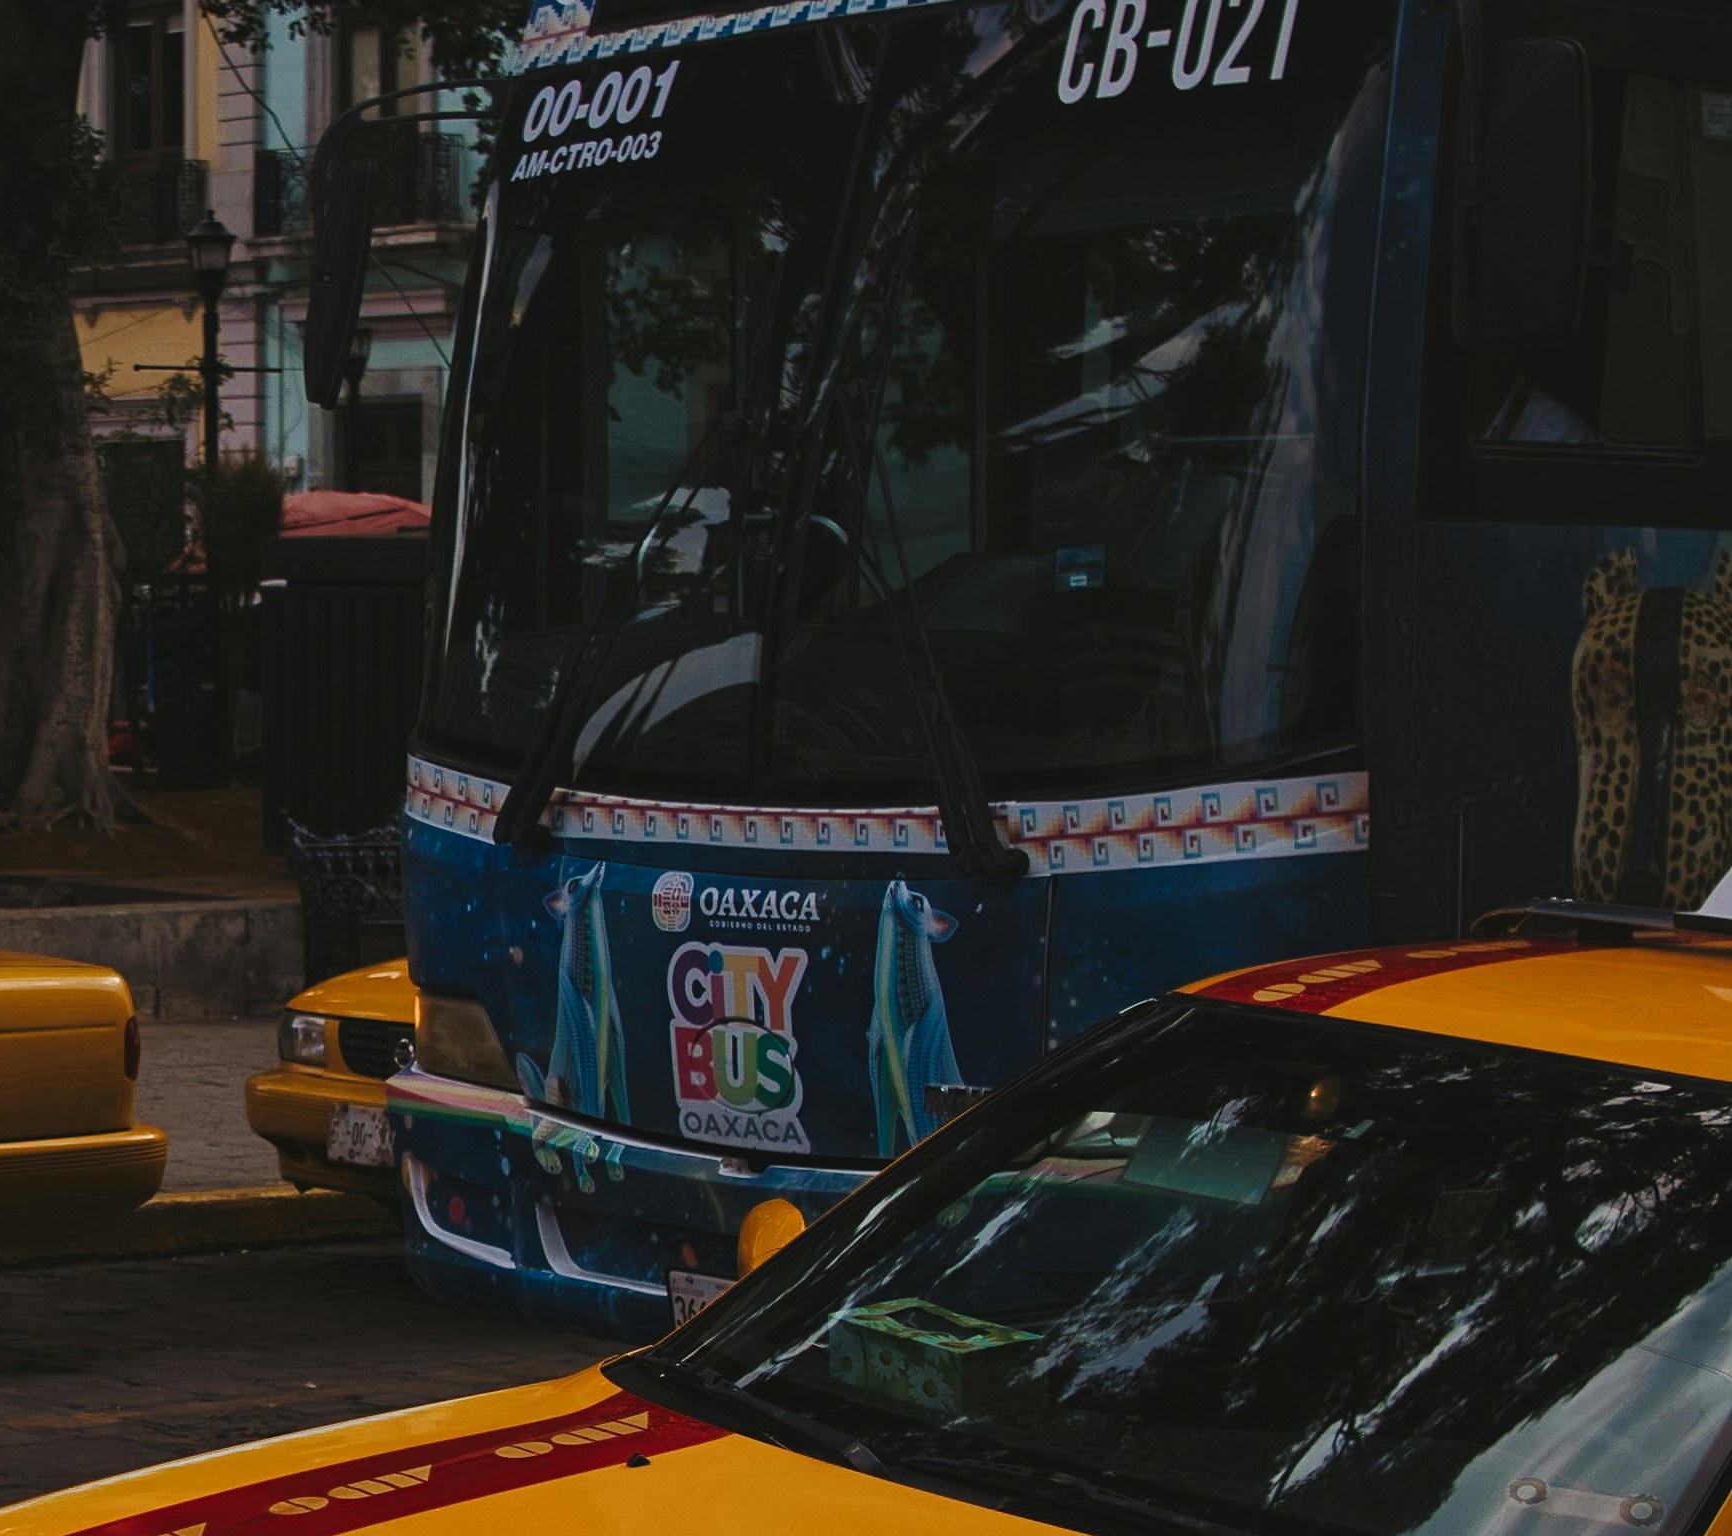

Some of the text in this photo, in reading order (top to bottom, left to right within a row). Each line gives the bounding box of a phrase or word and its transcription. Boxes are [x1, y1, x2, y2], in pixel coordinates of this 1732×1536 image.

[522, 59, 681, 143] 00-001
[509, 130, 663, 183] AM-CTRO-003
[699, 886, 820, 921] OAXACA
[709, 919, 811, 933] GOBIERNO DEL ESTADO
[674, 1026, 796, 1110] BUS
[683, 1111, 804, 1146] OAXACA
